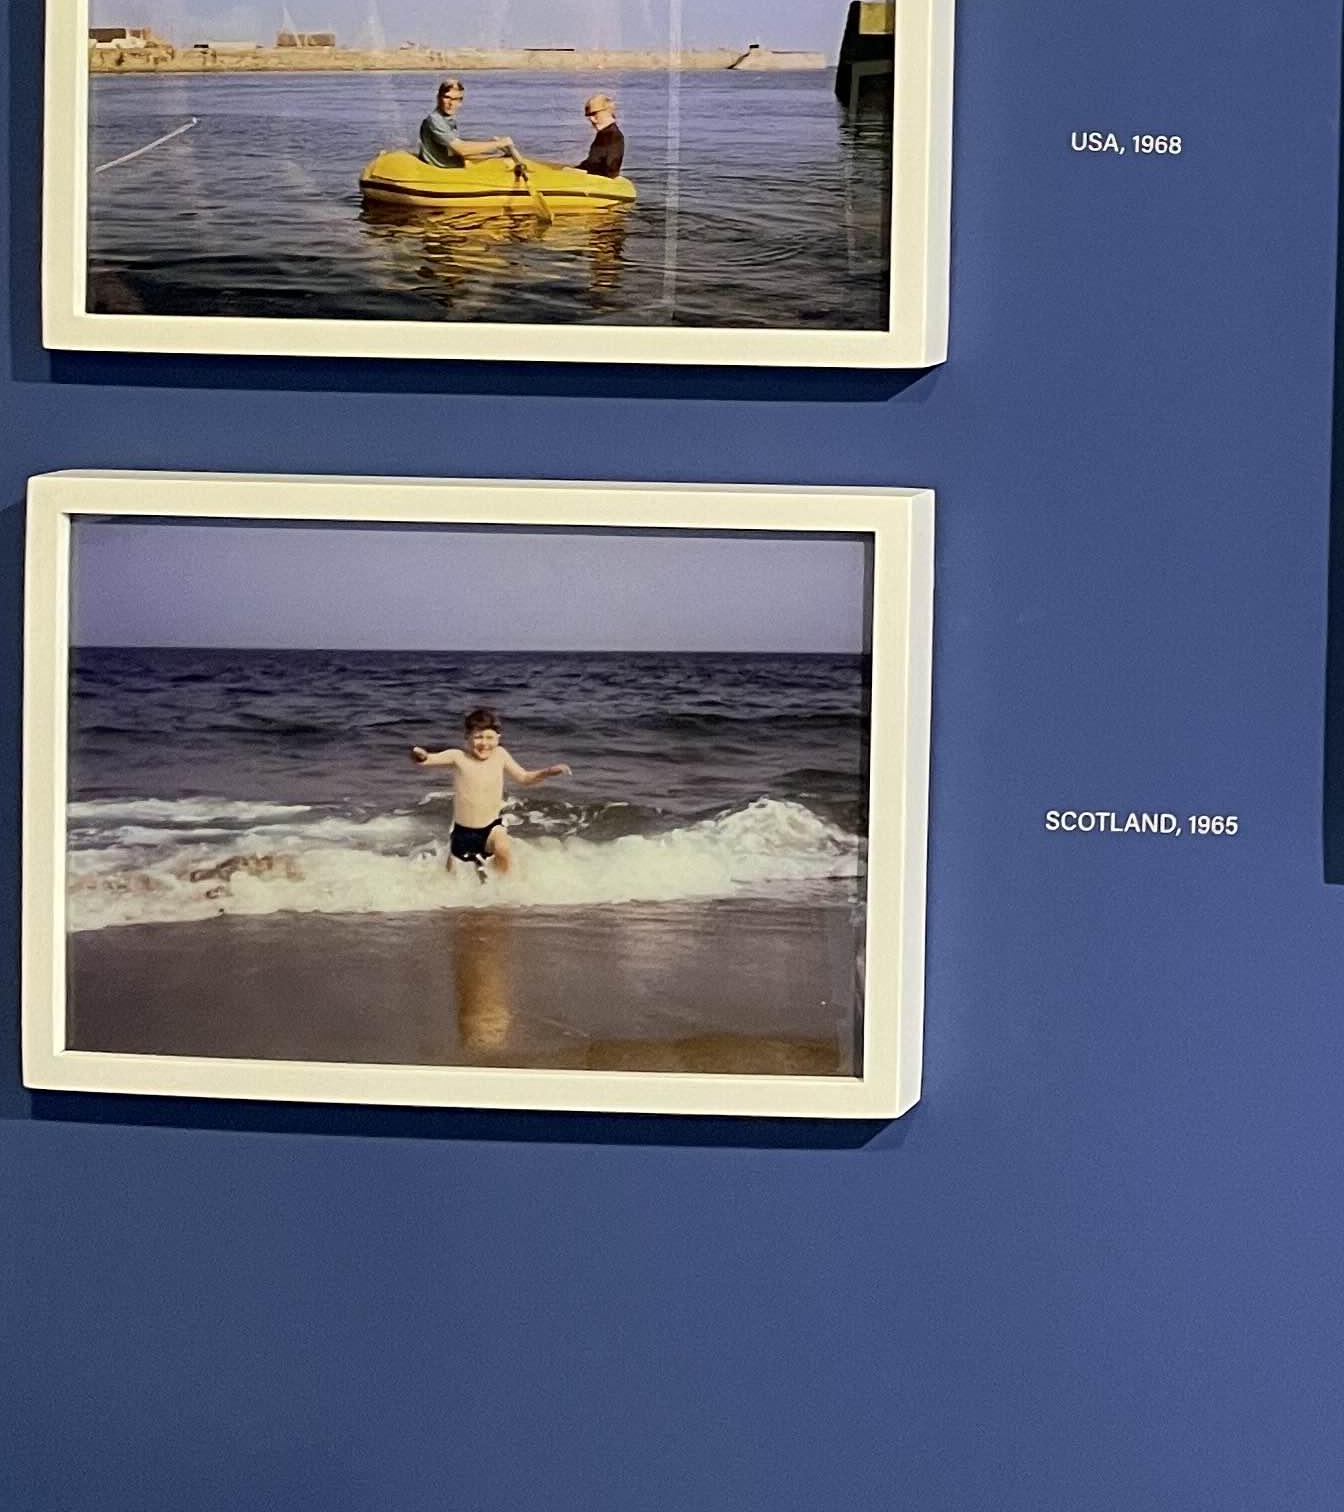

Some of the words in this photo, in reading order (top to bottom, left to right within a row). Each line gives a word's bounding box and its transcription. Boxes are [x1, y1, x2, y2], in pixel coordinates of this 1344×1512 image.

[1071, 132, 1125, 155] USA,
[1132, 134, 1182, 155] 1968
[1045, 810, 1183, 837] SCOTLAND,
[1188, 815, 1239, 836] 1965
